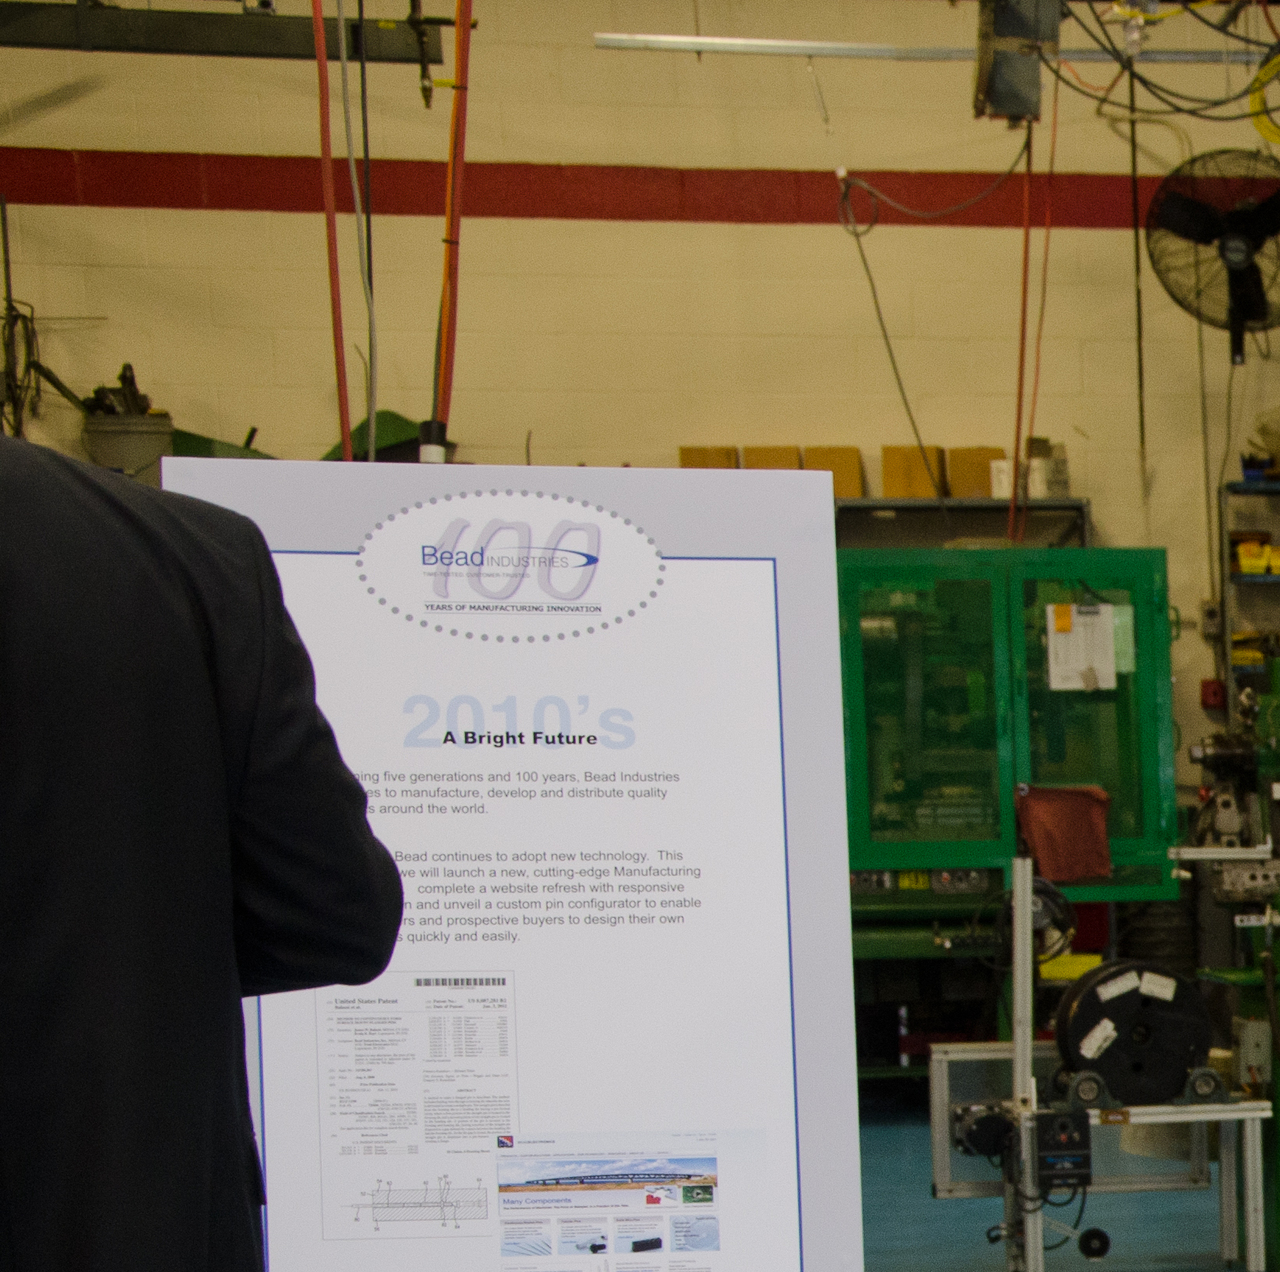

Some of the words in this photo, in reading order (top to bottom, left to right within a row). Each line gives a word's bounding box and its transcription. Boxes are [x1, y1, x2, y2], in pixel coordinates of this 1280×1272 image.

[421, 545, 484, 567] Bead
[486, 555, 569, 568] INDUSTRIES
[469, 604, 544, 612] MANUFACTURING
[546, 605, 602, 613] INNOVATION
[402, 694, 637, 750] 2010's
[442, 731, 457, 744] A
[463, 731, 526, 748] Bright
[532, 731, 599, 745] Future
[383, 770, 406, 782] five
[409, 771, 484, 785] generations
[487, 771, 511, 782] and
[516, 771, 539, 782] 100
[542, 773, 580, 785] years,
[583, 771, 617, 783] Bead
[620, 771, 680, 782] Industries
[384, 787, 397, 798] to
[400, 786, 484, 800] manufacture,
[487, 787, 537, 800] develop
[540, 787, 564, 798] and
[567, 787, 624, 798] distribute
[627, 787, 668, 800] quality
[379, 803, 424, 814] around
[427, 803, 448, 814] the
[450, 803, 489, 814] world.
[394, 851, 428, 862] Bead
[431, 851, 493, 862] continues
[495, 851, 508, 862] to
[511, 851, 547, 864] adopt
[550, 853, 577, 862] new
[579, 850, 650, 864] technology.
[657, 849, 684, 861] This
[400, 869, 416, 878] we
[419, 867, 440, 878] will
[443, 867, 485, 878] launch
[488, 869, 497, 878] a
[500, 869, 530, 880] new,
[533, 866, 610, 880] cutting-edge
[613, 865, 702, 879] Manufacturing
[417, 883, 476, 896] complete
[479, 885, 487, 894] a
[490, 883, 539, 894] website
[542, 882, 586, 894] refresh
[589, 882, 614, 893] with
[618, 884, 685, 895] responsive
[416, 899, 440, 910] and
[443, 899, 481, 910] unveil
[484, 901, 493, 910] a
[496, 899, 542, 910] custom
[545, 900, 564, 911] pin
[567, 897, 641, 912] configurator
[644, 898, 657, 909] to
[659, 897, 702, 909] enable
[419, 915, 443, 926] and
[446, 915, 519, 928] prospective
[522, 914, 565, 928] buyers
[568, 914, 581, 925] to
[583, 914, 625, 927] design
[628, 914, 656, 925] their
[658, 915, 685, 924] own
[406, 931, 451, 945] quickly
[454, 931, 478, 942] and
[481, 930, 521, 944] easily.
[502, 1198, 522, 1206] Many
[525, 1197, 572, 1205] Components
